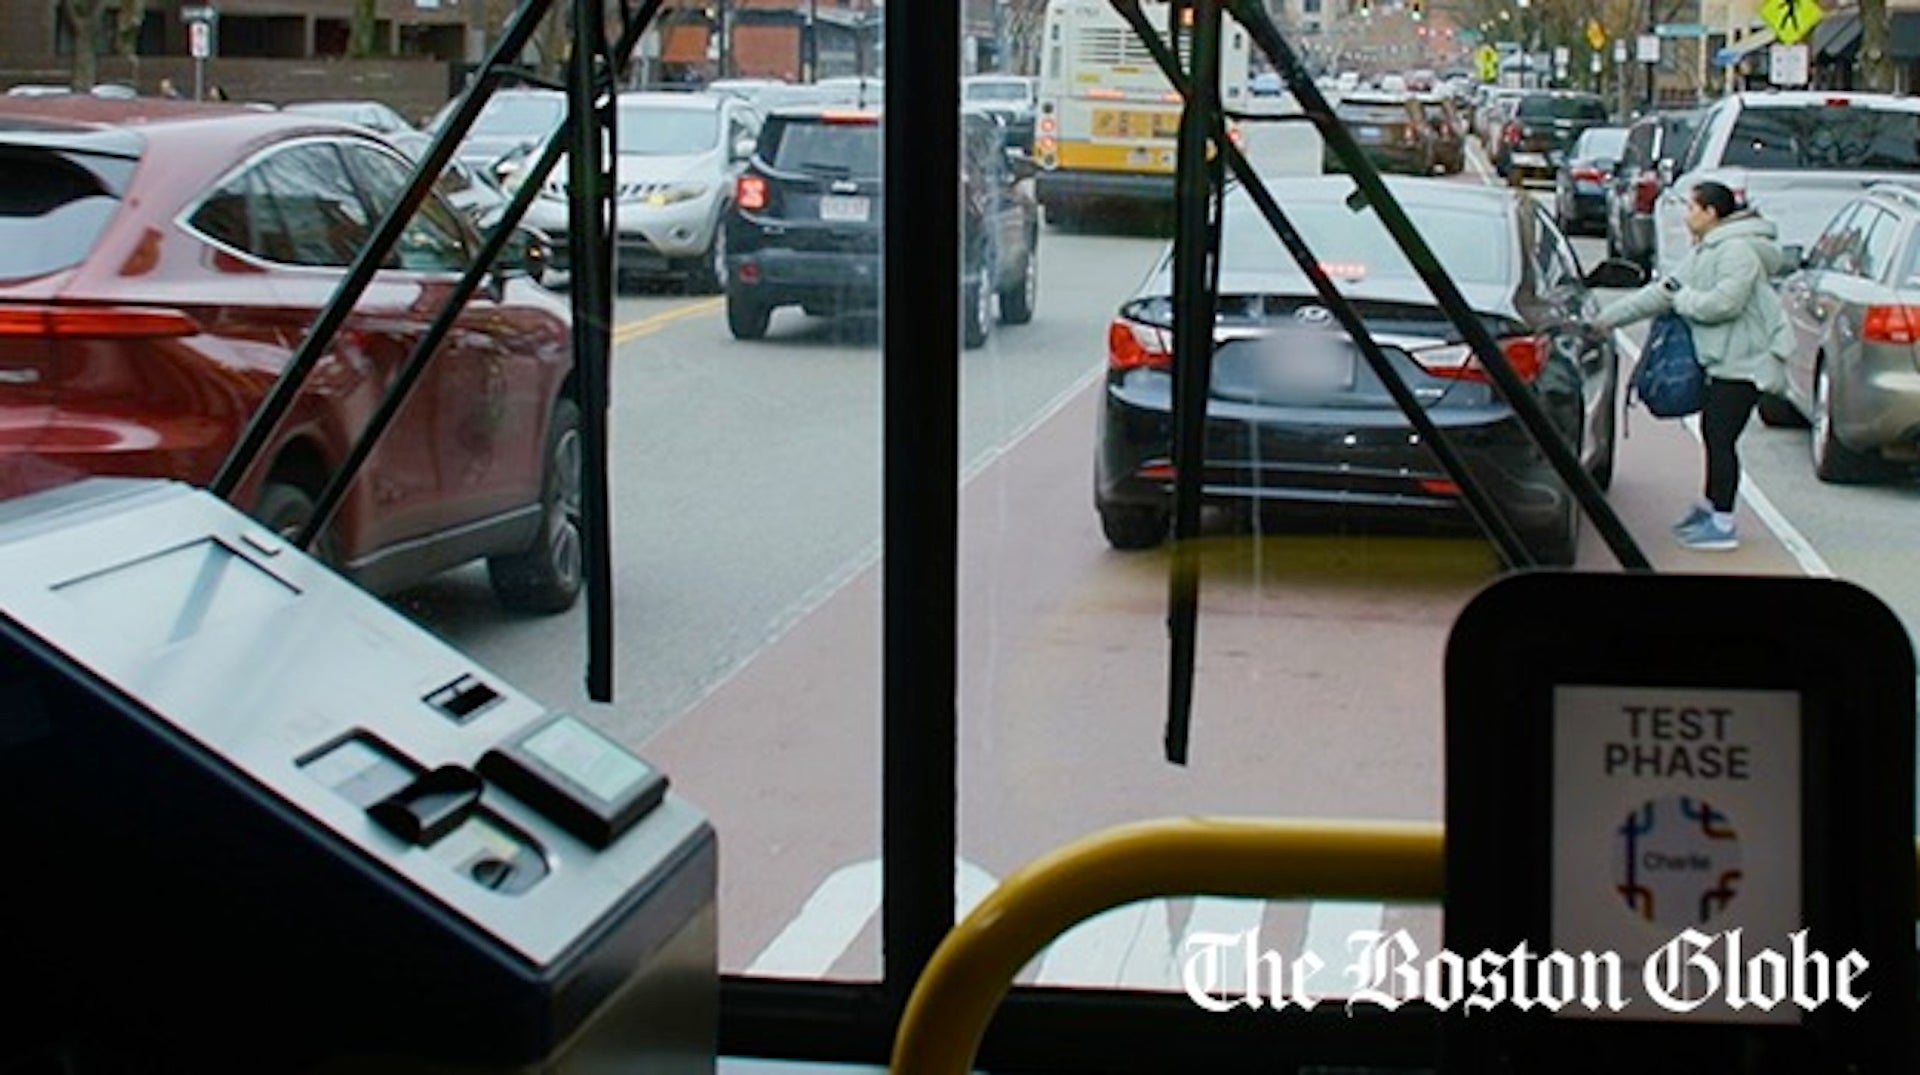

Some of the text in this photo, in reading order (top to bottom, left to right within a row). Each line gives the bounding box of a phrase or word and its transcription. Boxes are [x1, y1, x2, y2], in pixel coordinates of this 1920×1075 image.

[1622, 706, 1733, 742] TEST
[1604, 743, 1750, 780] PHASE
[1643, 851, 1711, 872] Charlie
